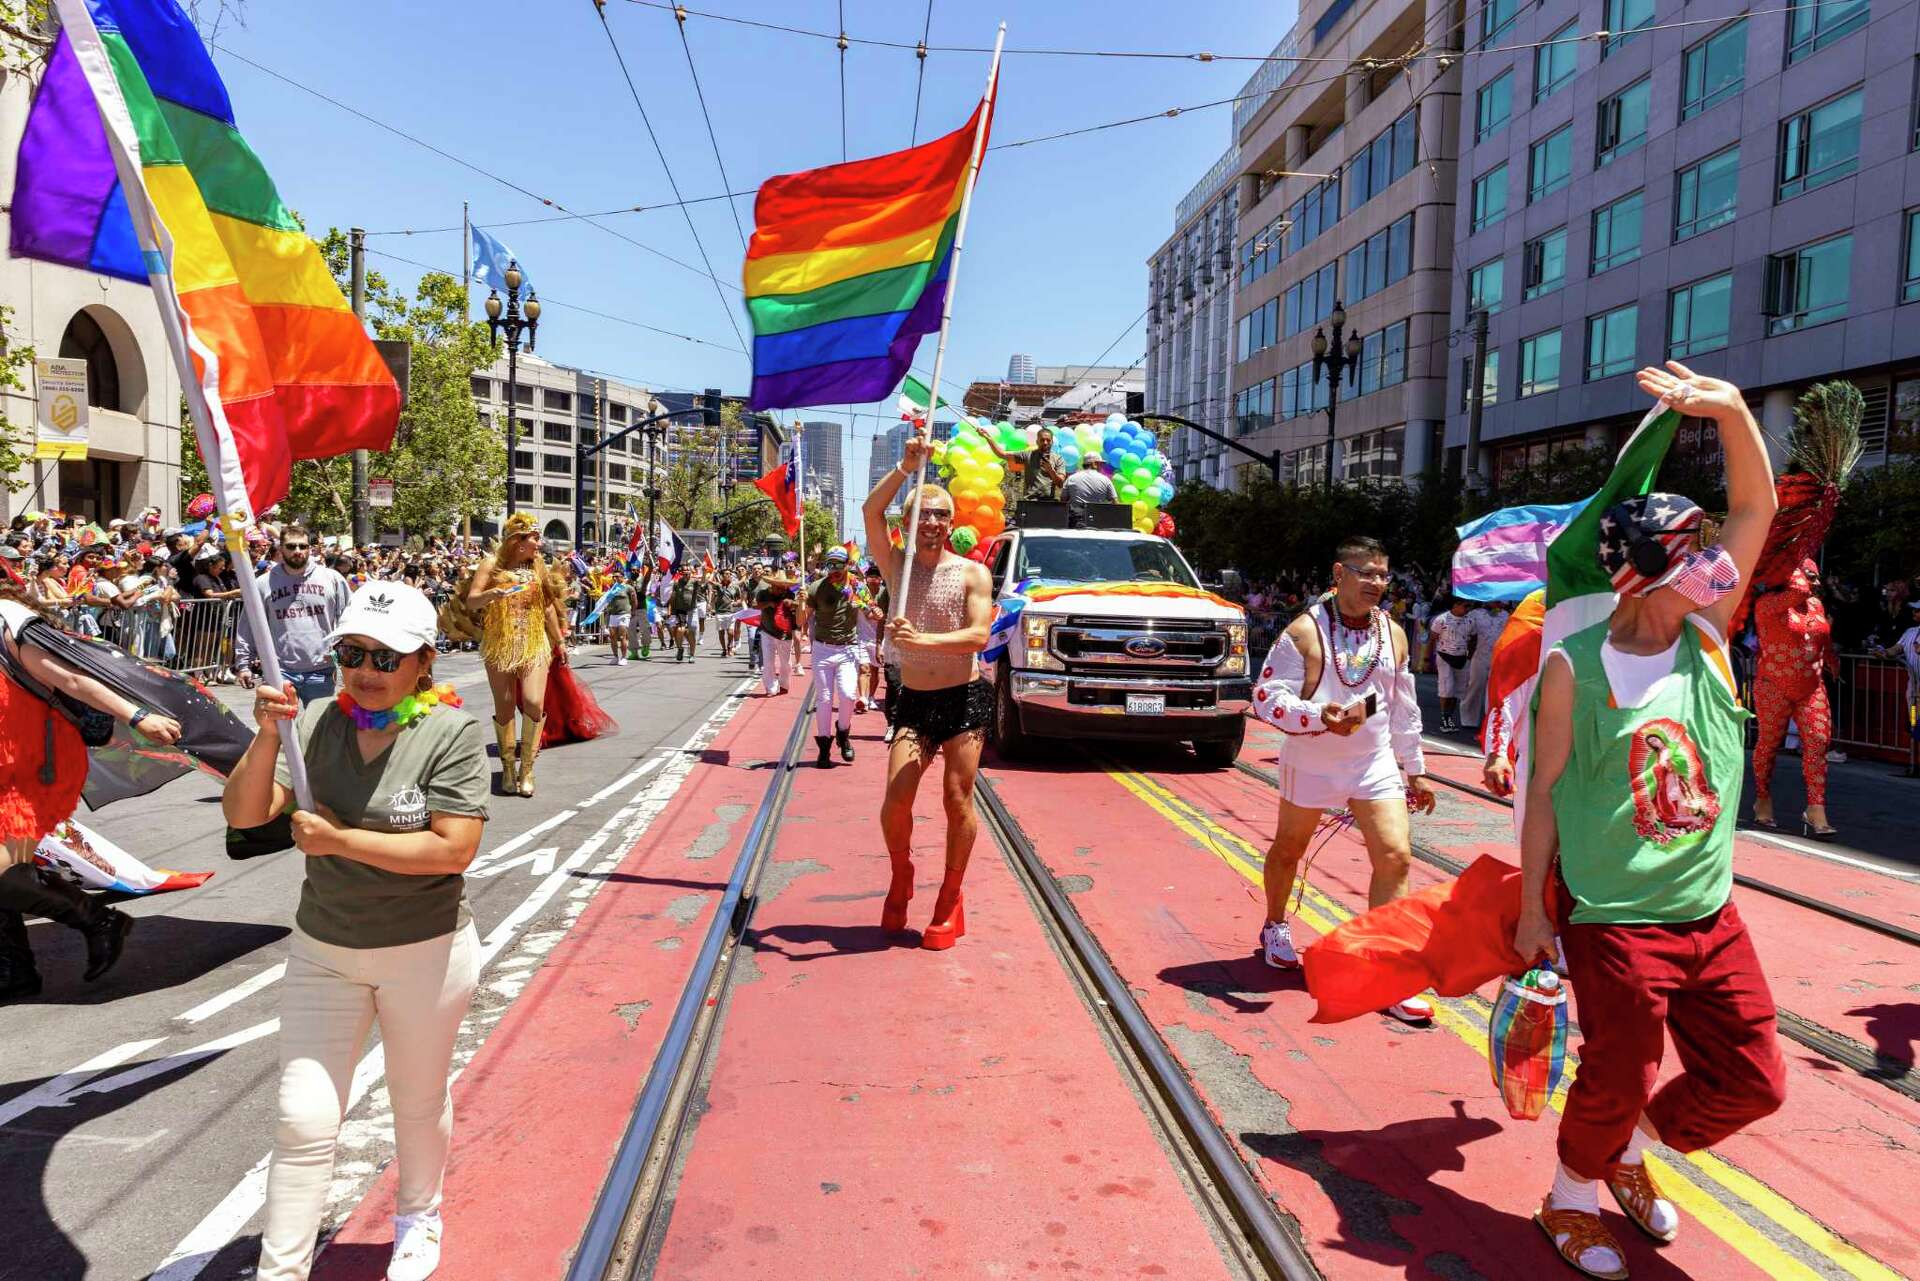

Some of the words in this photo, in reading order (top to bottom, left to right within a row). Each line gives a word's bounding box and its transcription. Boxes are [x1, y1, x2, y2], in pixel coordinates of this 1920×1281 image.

[270, 586, 291, 602] CAL
[293, 583, 325, 597] STATE
[275, 607, 303, 620] EAST
[305, 604, 325, 617] BAY
[389, 811, 431, 824] MNHC
